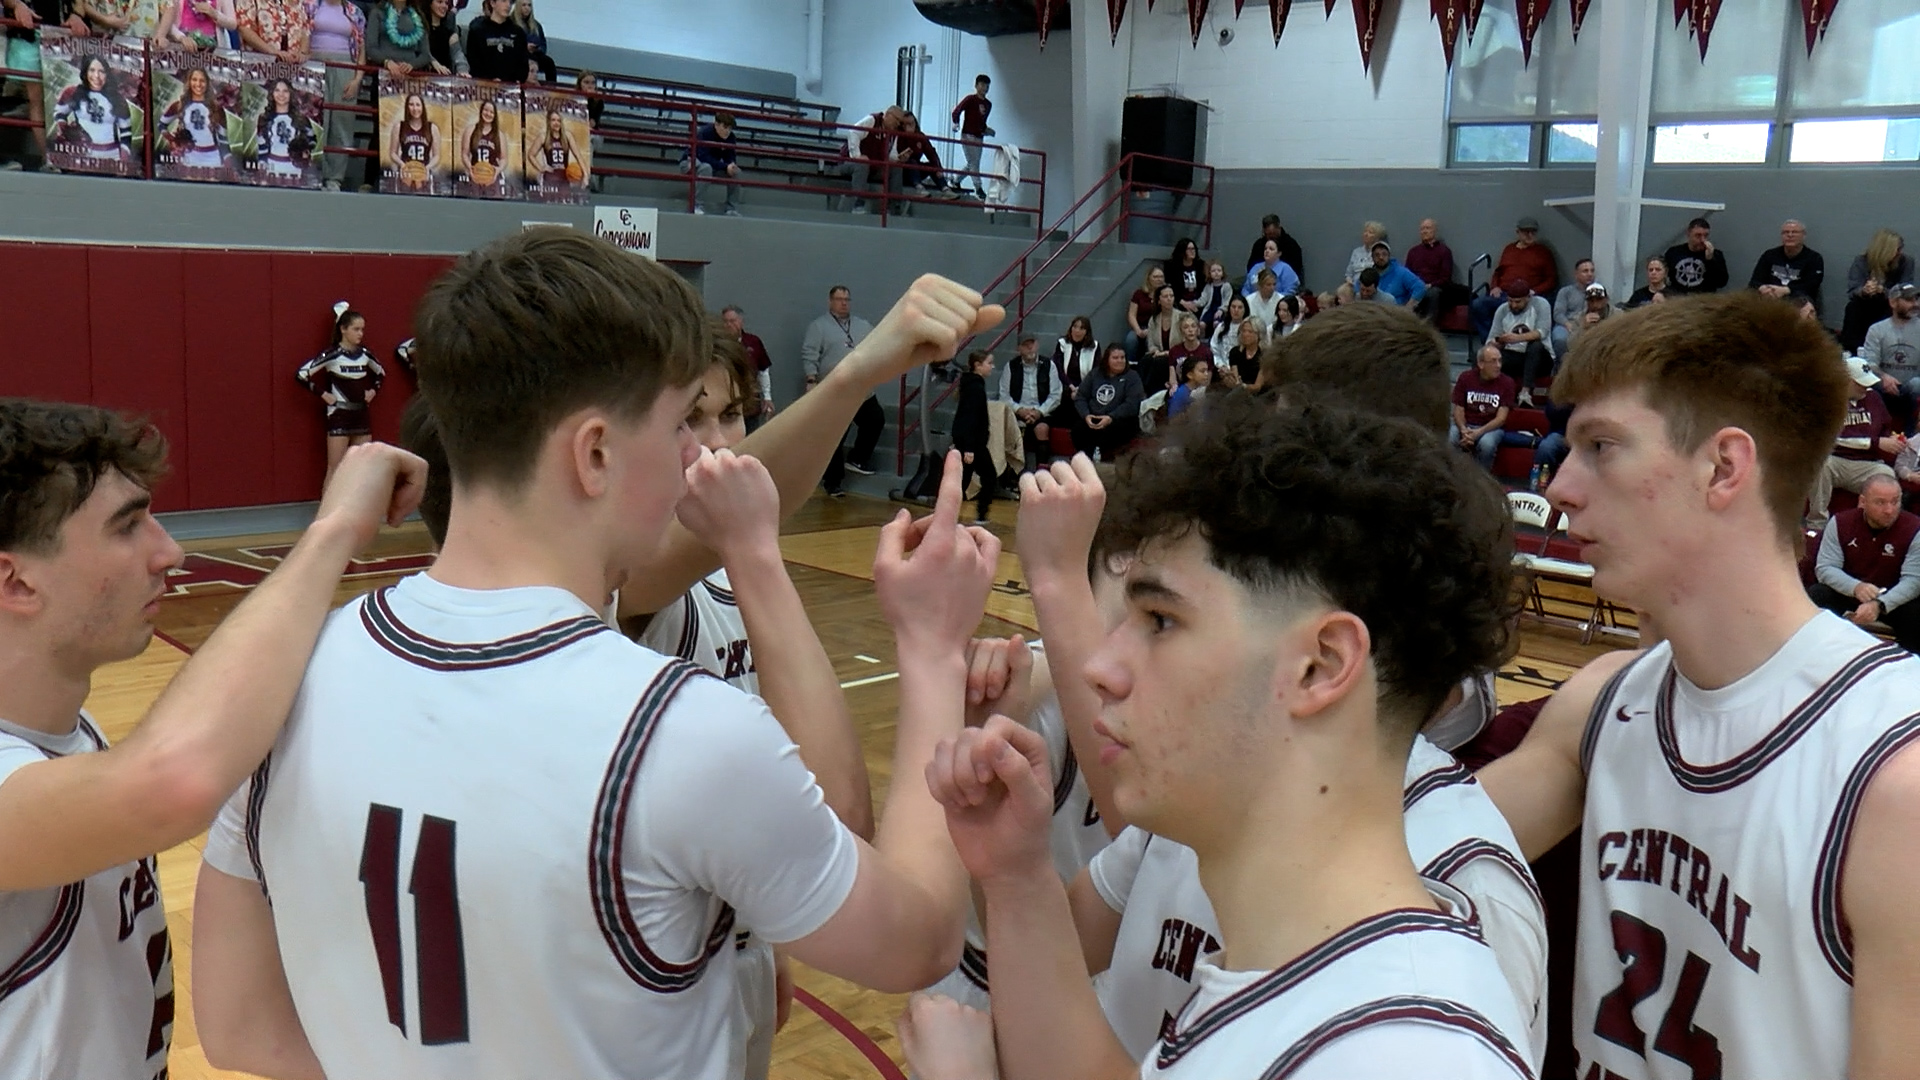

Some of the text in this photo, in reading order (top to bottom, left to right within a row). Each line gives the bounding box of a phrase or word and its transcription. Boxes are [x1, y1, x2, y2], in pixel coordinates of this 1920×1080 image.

[407, 145, 425, 160] 42
[477, 148, 490, 162] 12
[552, 149, 564, 162] 25
[1466, 391, 1500, 408] KNIGHTS
[1598, 828, 1761, 975] CENTRAL
[359, 802, 470, 1046] 11
